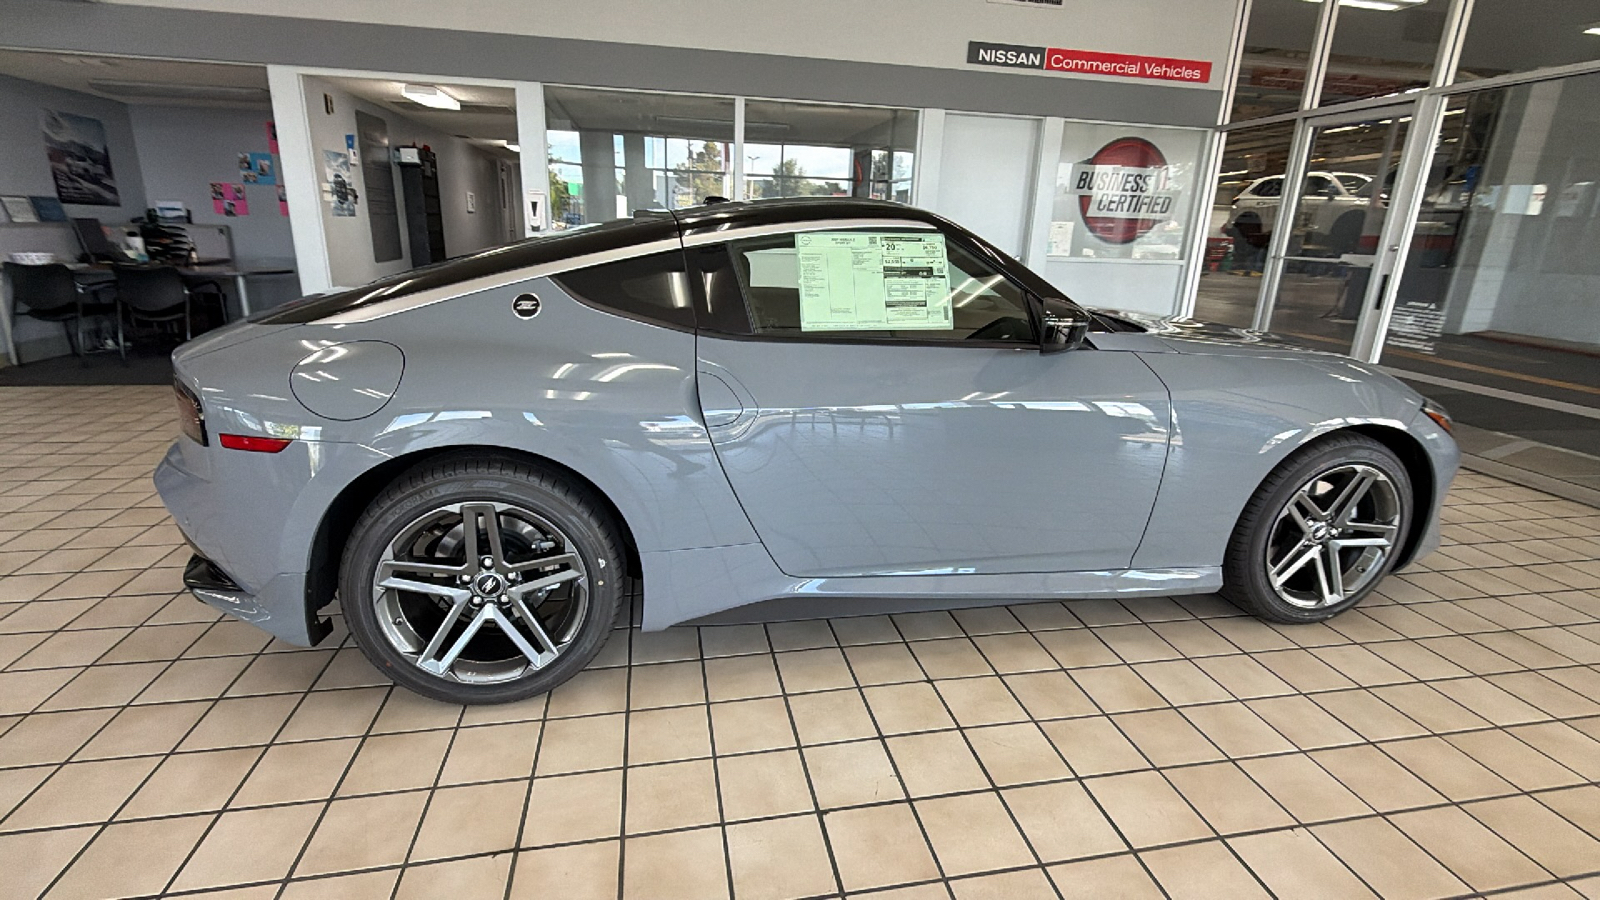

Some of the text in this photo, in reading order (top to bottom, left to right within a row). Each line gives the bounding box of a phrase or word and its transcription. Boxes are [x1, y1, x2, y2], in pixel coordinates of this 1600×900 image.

[978, 48, 1041, 66] NISSAN
[1051, 54, 1201, 79] Commercial Vehicles
[1076, 171, 1153, 193] BUSINESS
[1096, 194, 1173, 214] CERTIFIED
[886, 243, 896, 251] 20
